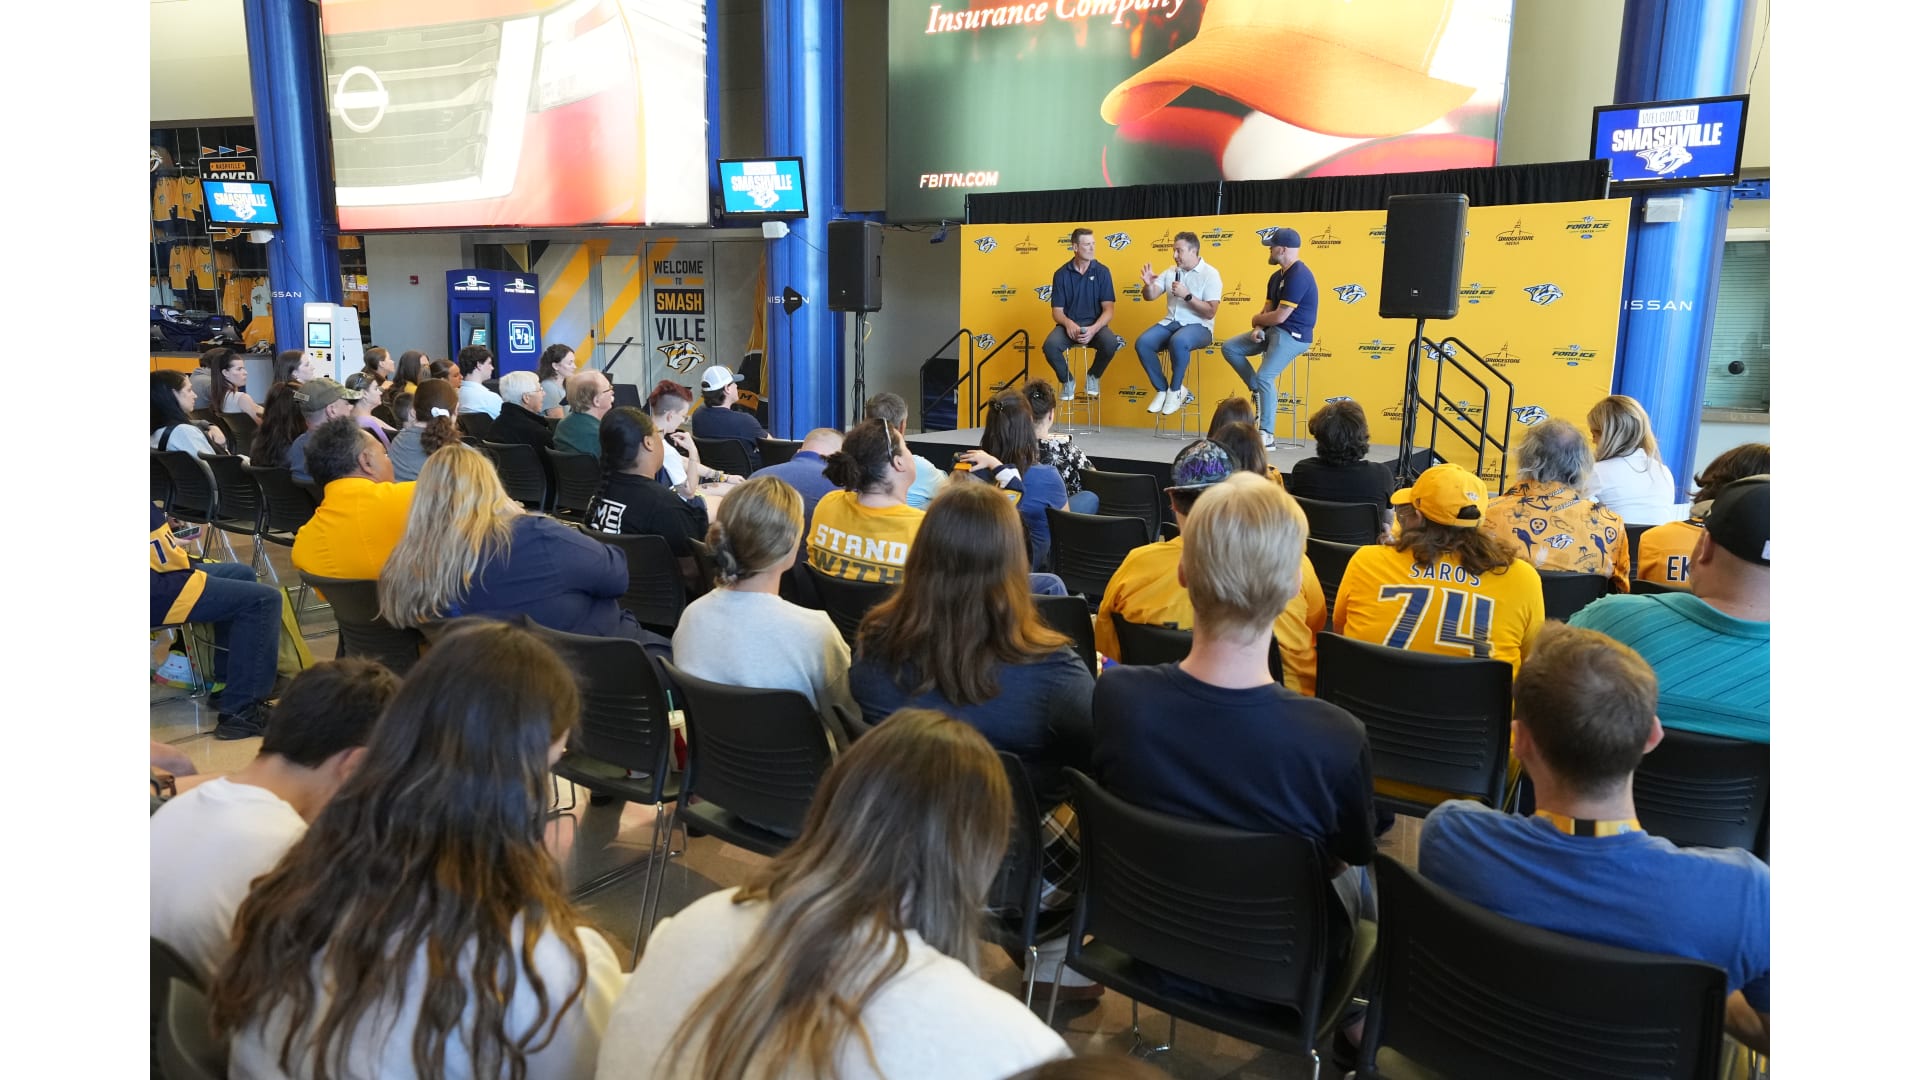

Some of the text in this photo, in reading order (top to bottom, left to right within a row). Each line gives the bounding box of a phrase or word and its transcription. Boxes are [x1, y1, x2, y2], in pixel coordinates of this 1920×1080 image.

[925, 0, 1185, 34] Insurance Company
[1611, 122, 1724, 152] SMASHVILLE
[919, 171, 999, 189] FBITN.COM
[653, 260, 704, 275] WELCOME
[675, 277, 682, 285] TO
[656, 292, 702, 311] SMASH
[1624, 300, 1693, 311] ISSAN
[655, 317, 706, 342] VILLE
[815, 523, 907, 565] STAND
[813, 548, 905, 584] WITH
[1409, 562, 1481, 588] SAROS
[1378, 584, 1496, 659] 74
